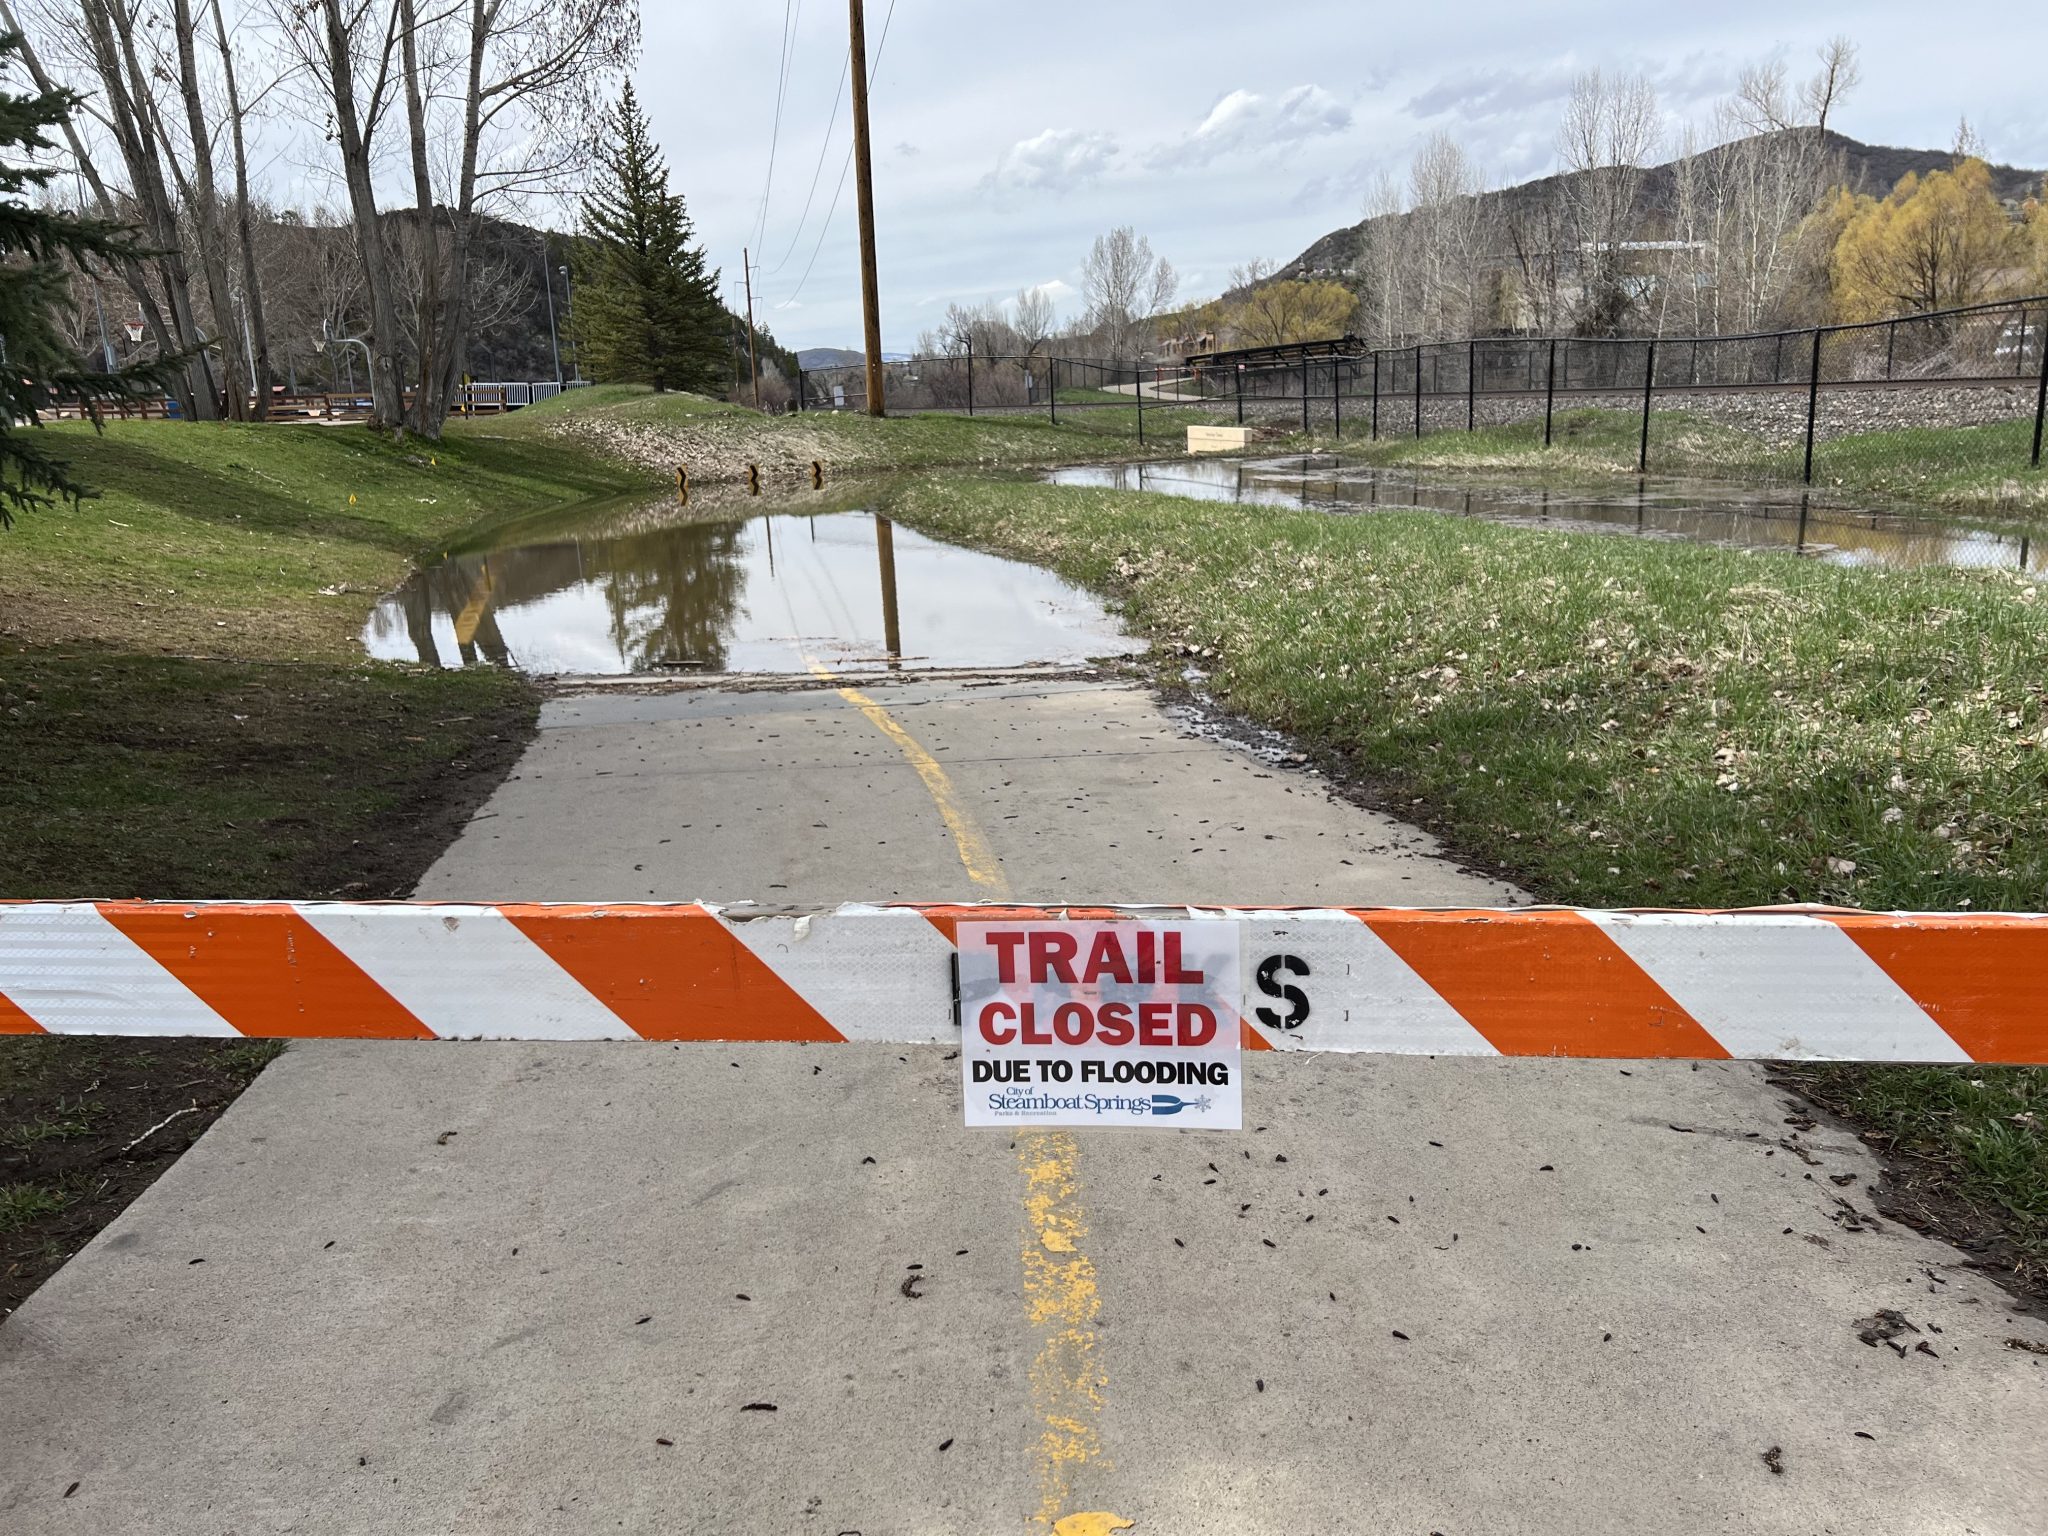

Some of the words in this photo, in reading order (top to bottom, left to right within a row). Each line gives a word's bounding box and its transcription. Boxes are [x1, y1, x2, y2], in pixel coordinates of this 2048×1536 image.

[986, 931, 1204, 985] TRAIL
[979, 1002, 1217, 1046] CLOSED
[972, 1060, 1031, 1083] DUE
[1036, 1060, 1073, 1083] TO
[1081, 1061, 1229, 1085] FLOODING
[989, 1093, 1083, 1110] Steamboat
[1084, 1095, 1151, 1115] Springs
[1006, 1087, 1024, 1099] City
[1025, 1087, 1035, 1096] of
